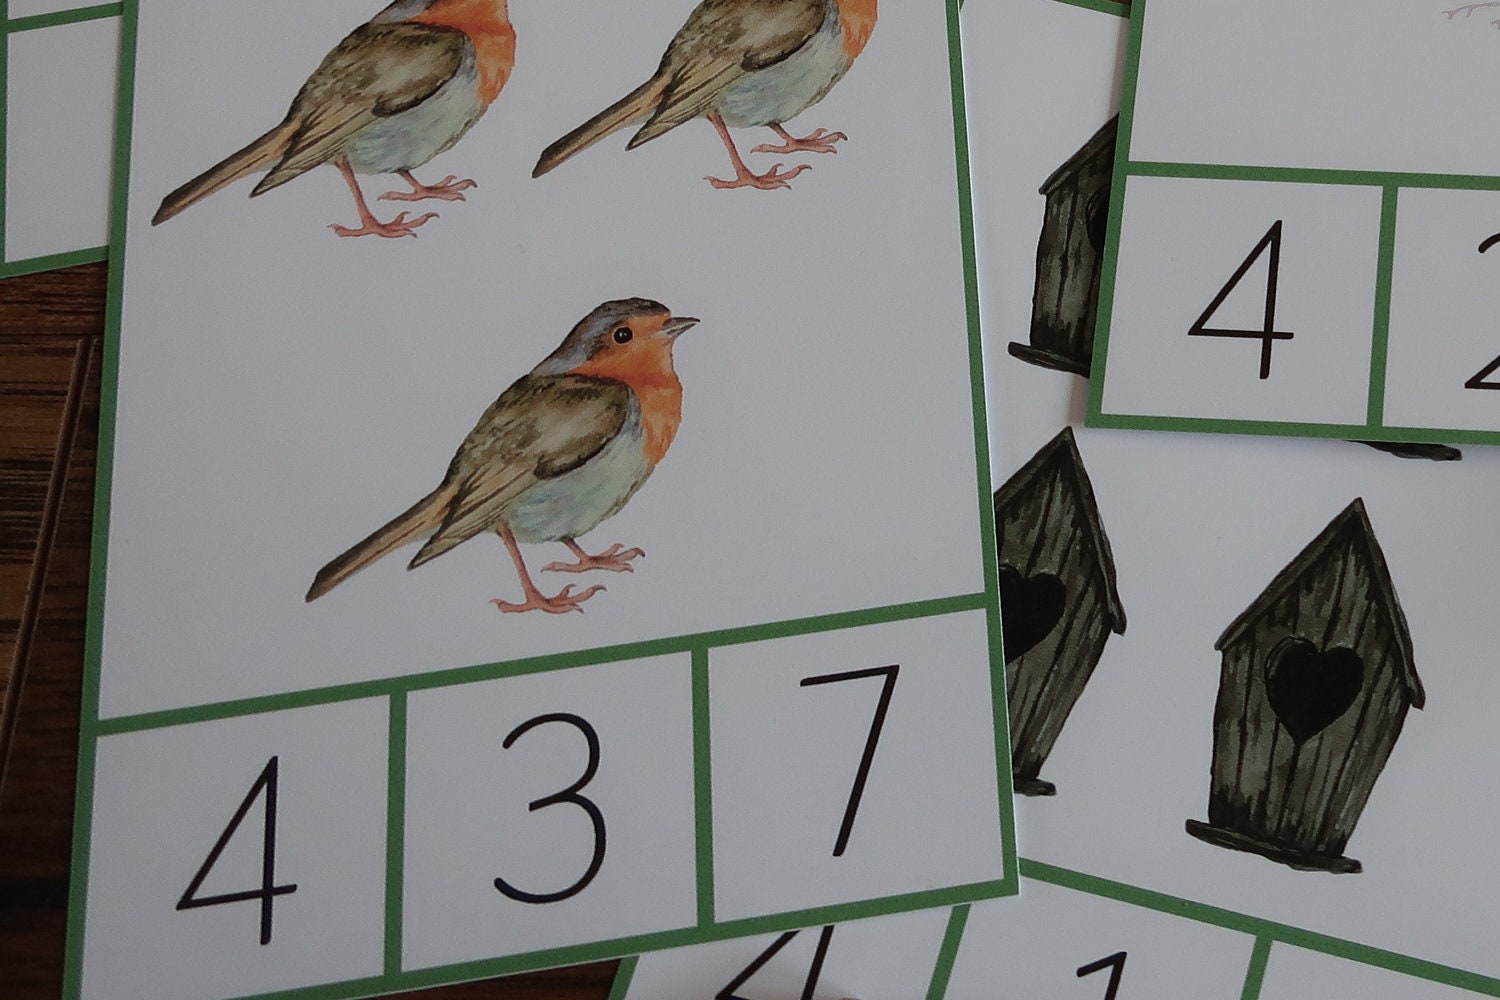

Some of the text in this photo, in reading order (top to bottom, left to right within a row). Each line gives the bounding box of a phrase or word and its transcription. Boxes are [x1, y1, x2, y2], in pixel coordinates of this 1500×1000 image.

[1187, 219, 1294, 380] 4
[175, 664, 900, 946] 4 3 7
